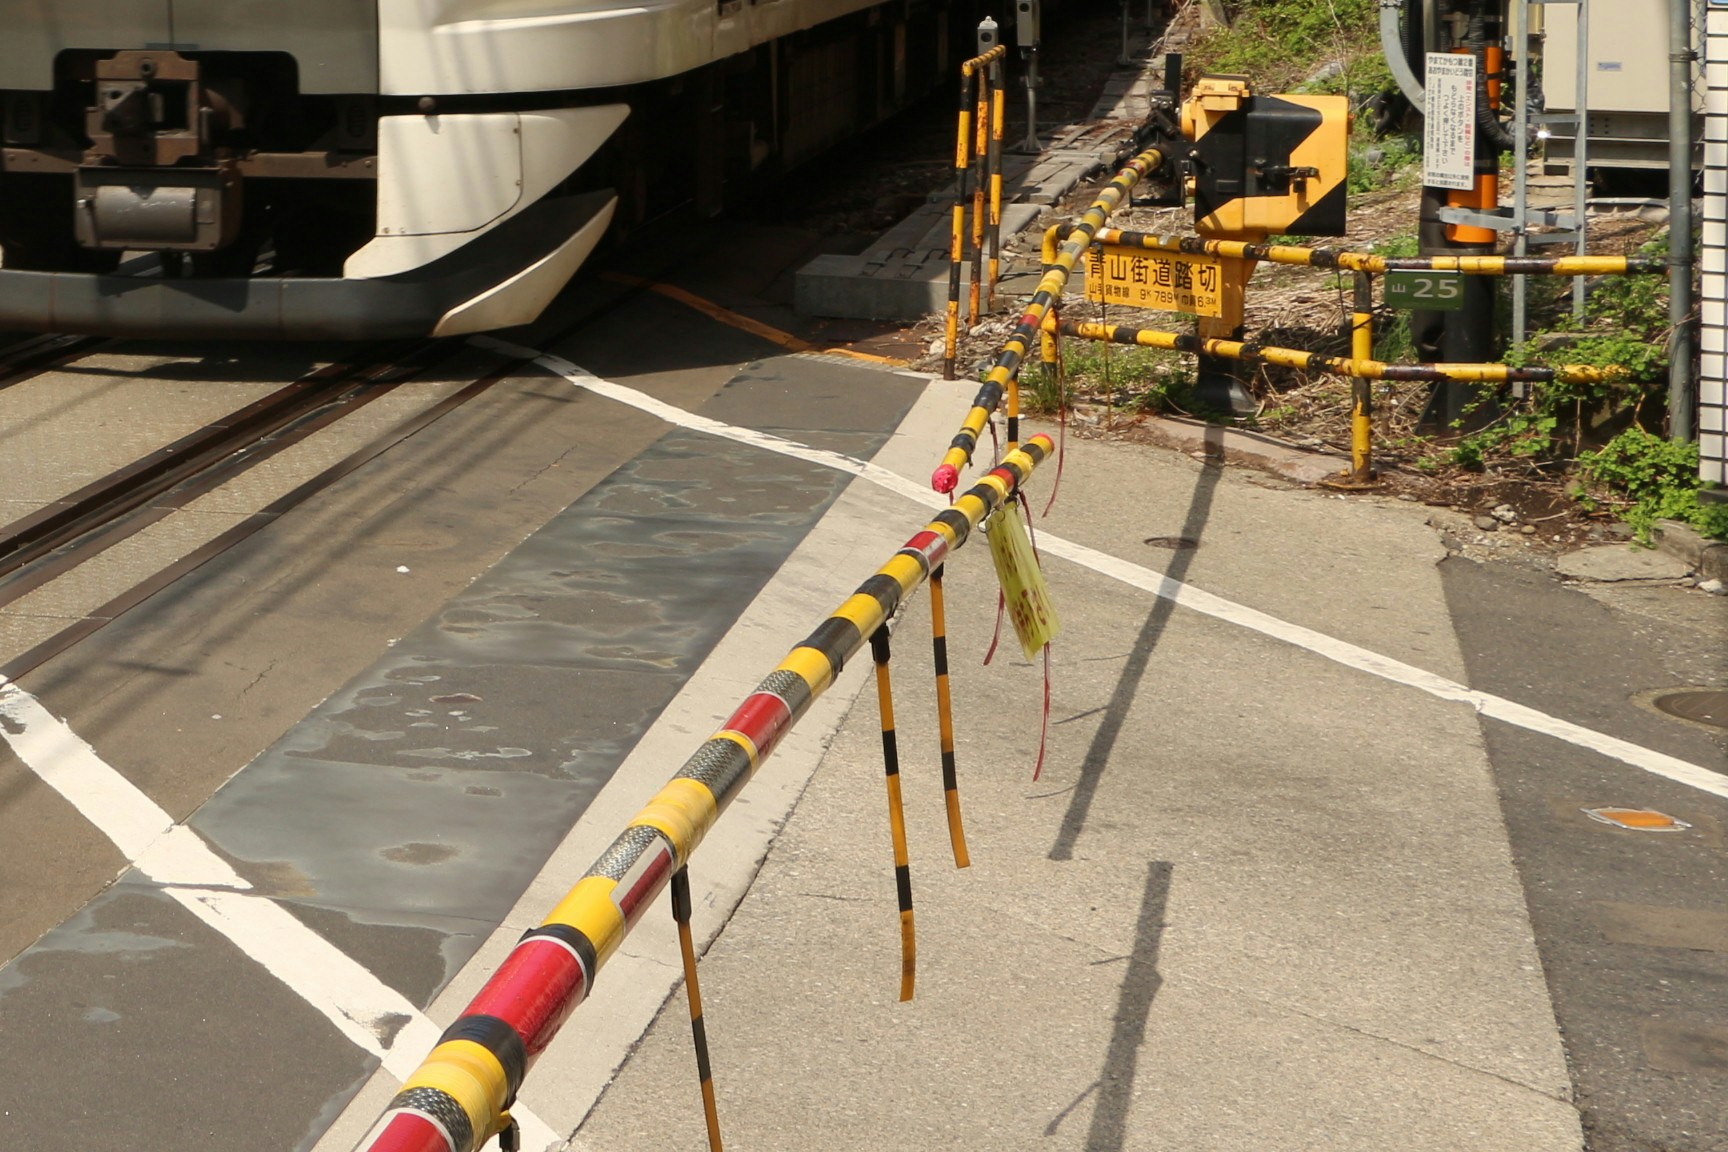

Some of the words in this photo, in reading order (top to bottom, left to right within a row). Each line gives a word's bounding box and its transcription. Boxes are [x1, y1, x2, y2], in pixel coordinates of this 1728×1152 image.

[1089, 252, 1217, 293] 青山街道踏切
[1391, 282, 1406, 293] 山
[1412, 278, 1459, 299] 25
